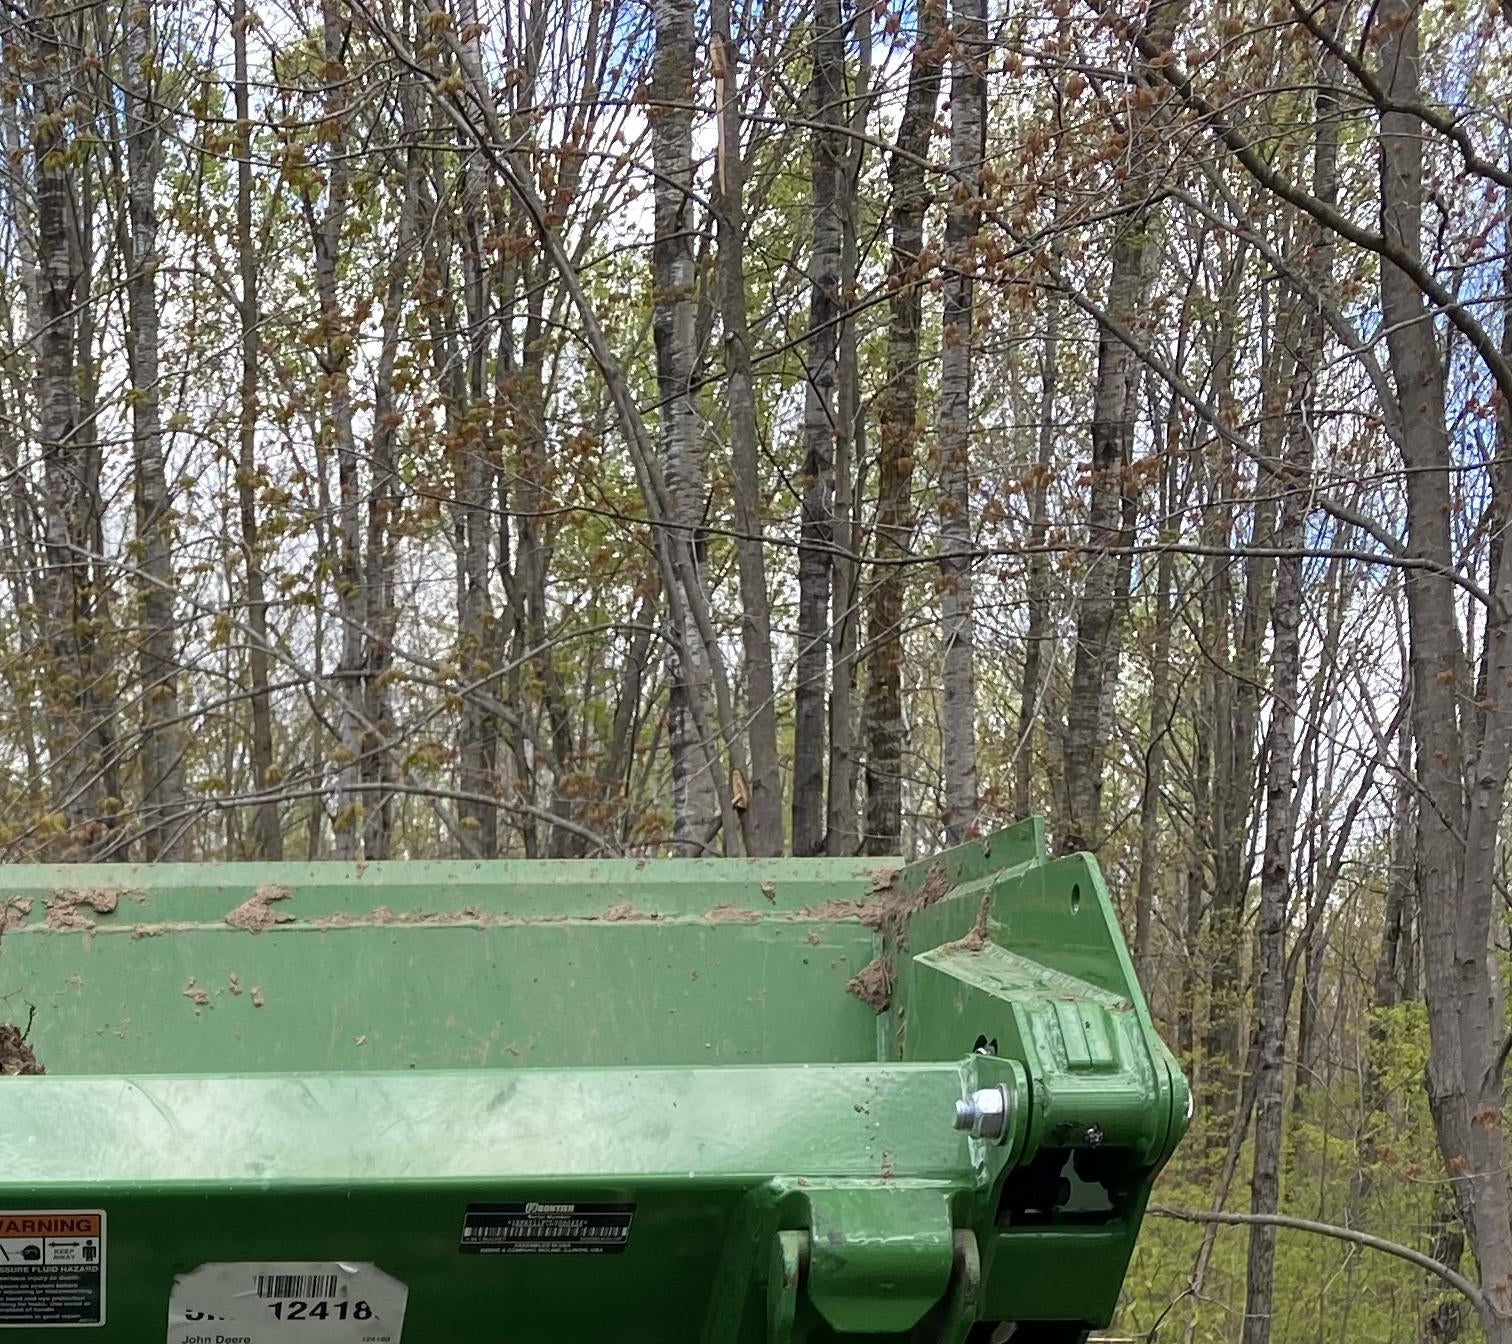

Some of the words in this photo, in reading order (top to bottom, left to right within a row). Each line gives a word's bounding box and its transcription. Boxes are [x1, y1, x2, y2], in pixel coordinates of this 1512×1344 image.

[60, 1265, 99, 1273] HAZARD
[268, 1300, 380, 1321] 12418
[181, 1335, 212, 1344] John
[216, 1335, 251, 1344] Deere
